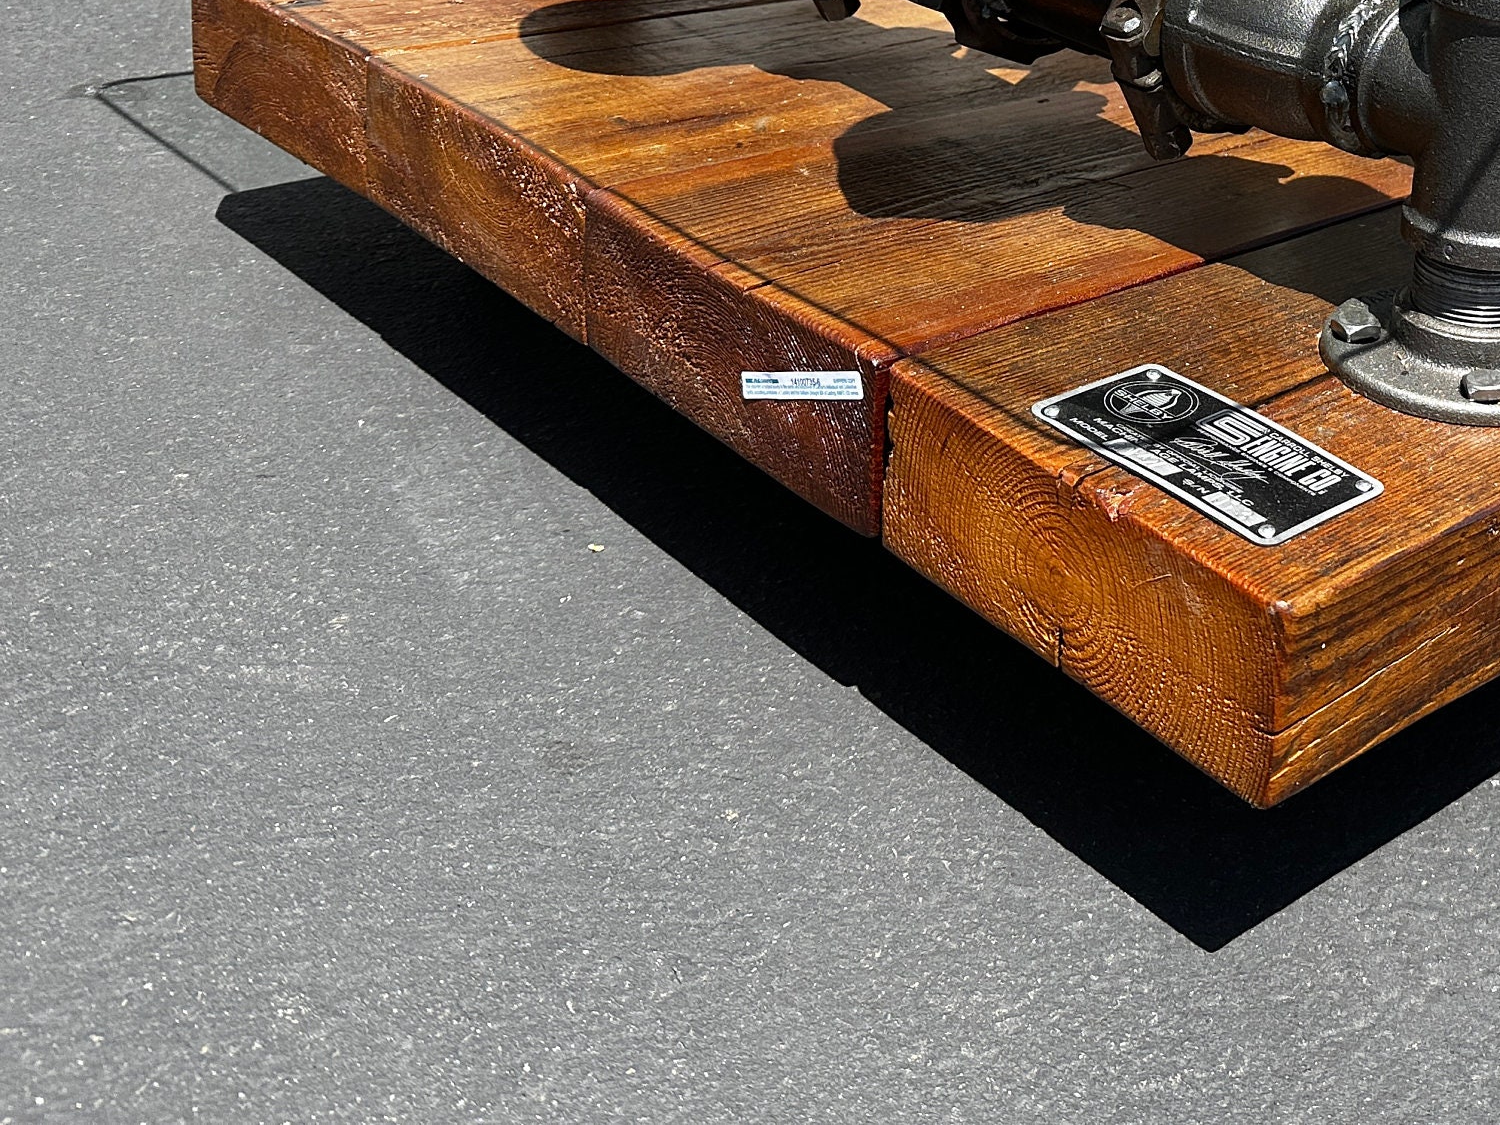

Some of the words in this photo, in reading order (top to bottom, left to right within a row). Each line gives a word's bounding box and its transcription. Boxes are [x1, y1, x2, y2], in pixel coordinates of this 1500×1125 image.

[1113, 388, 1173, 421] SHELBY
[1068, 417, 1111, 440] MODEL
[1149, 448, 1179, 464] AGE
[1239, 436, 1315, 477] ENGINE
[1269, 432, 1312, 457] CARROLL
[1310, 456, 1349, 477] SHELBY
